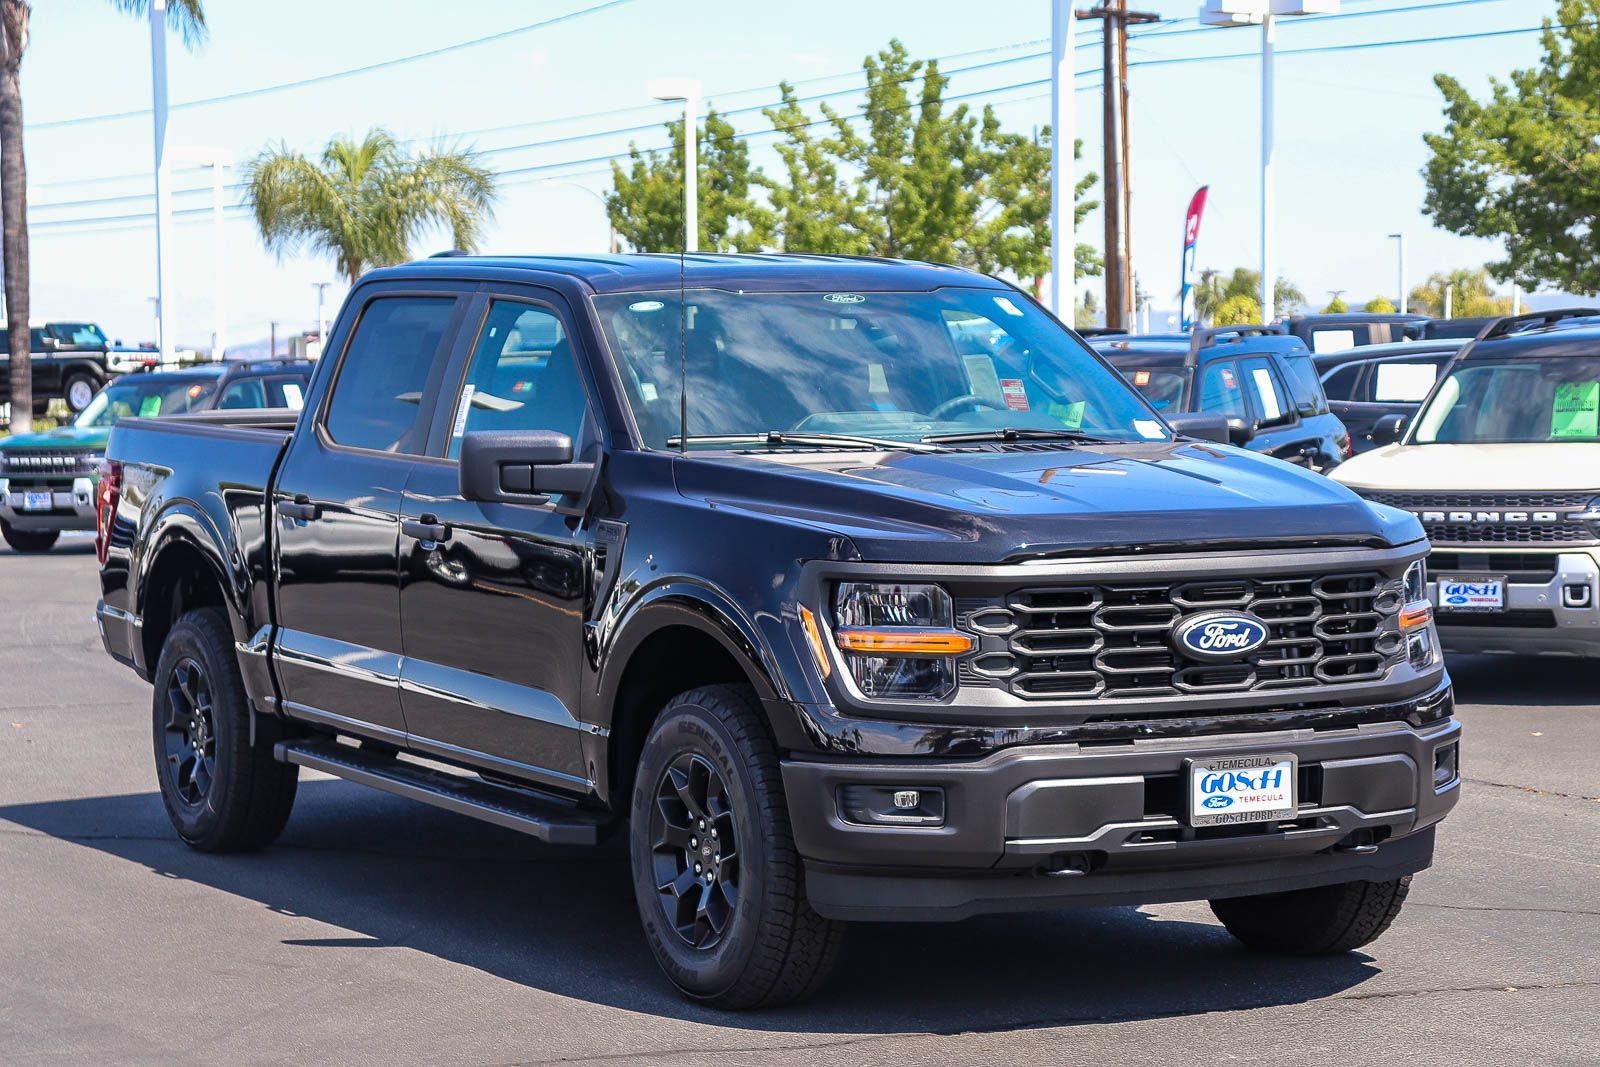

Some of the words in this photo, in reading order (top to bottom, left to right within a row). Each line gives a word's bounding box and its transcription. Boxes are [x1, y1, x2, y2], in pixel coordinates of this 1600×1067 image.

[1411, 511, 1557, 523] RONCO
[1446, 584, 1497, 595] GOSCH
[1199, 623, 1251, 649] Ford
[1216, 757, 1271, 770] TEMECULA
[1200, 769, 1282, 793] GOSCH
[1208, 797, 1228, 808] Ford
[1239, 794, 1284, 804] TEMECULA
[1248, 811, 1273, 821] FORD
